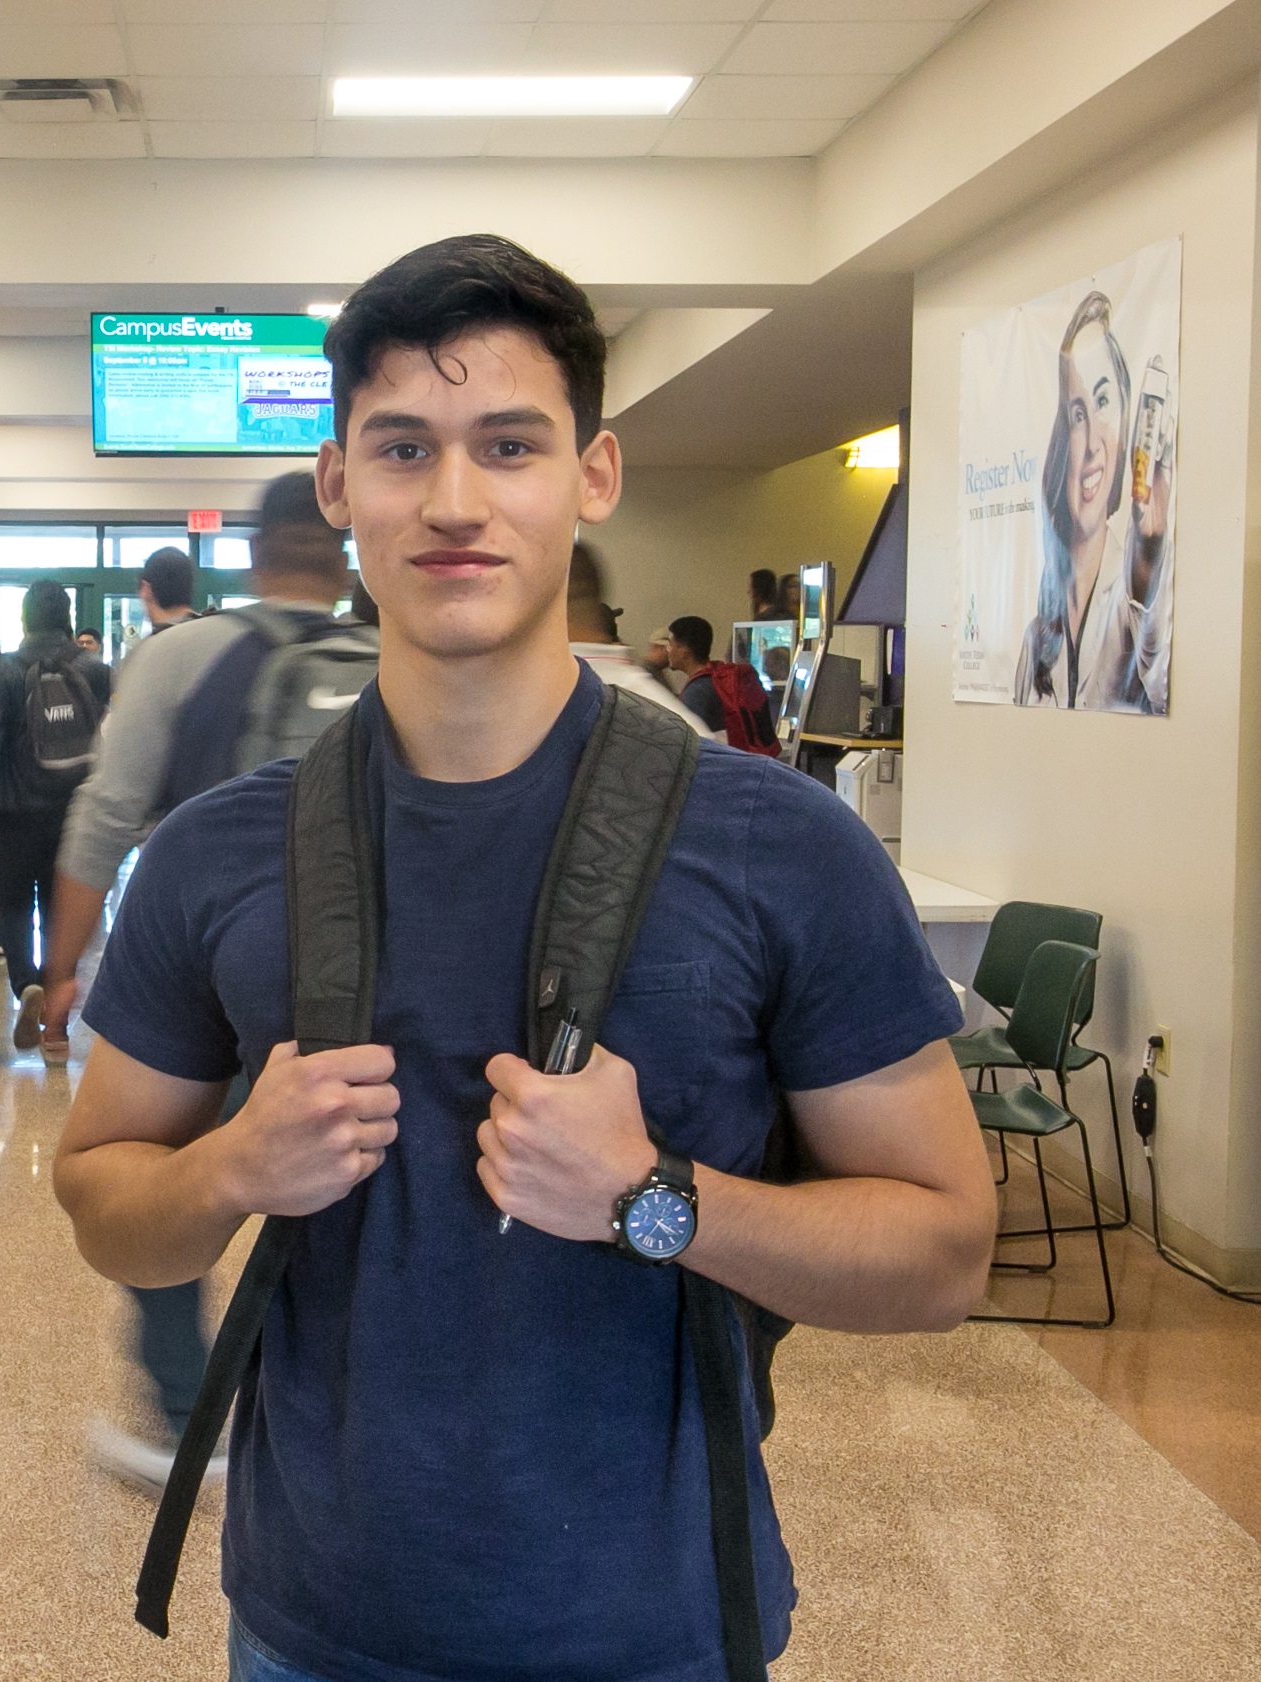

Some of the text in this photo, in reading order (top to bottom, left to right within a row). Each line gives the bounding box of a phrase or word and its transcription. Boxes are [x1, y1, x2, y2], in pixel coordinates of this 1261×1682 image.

[99, 315, 253, 342] CampusEvents
[103, 356, 142, 365] September
[244, 370, 330, 378] WORKSHOPS
[255, 403, 317, 416] JAGUARS
[965, 457, 1010, 502] Register
